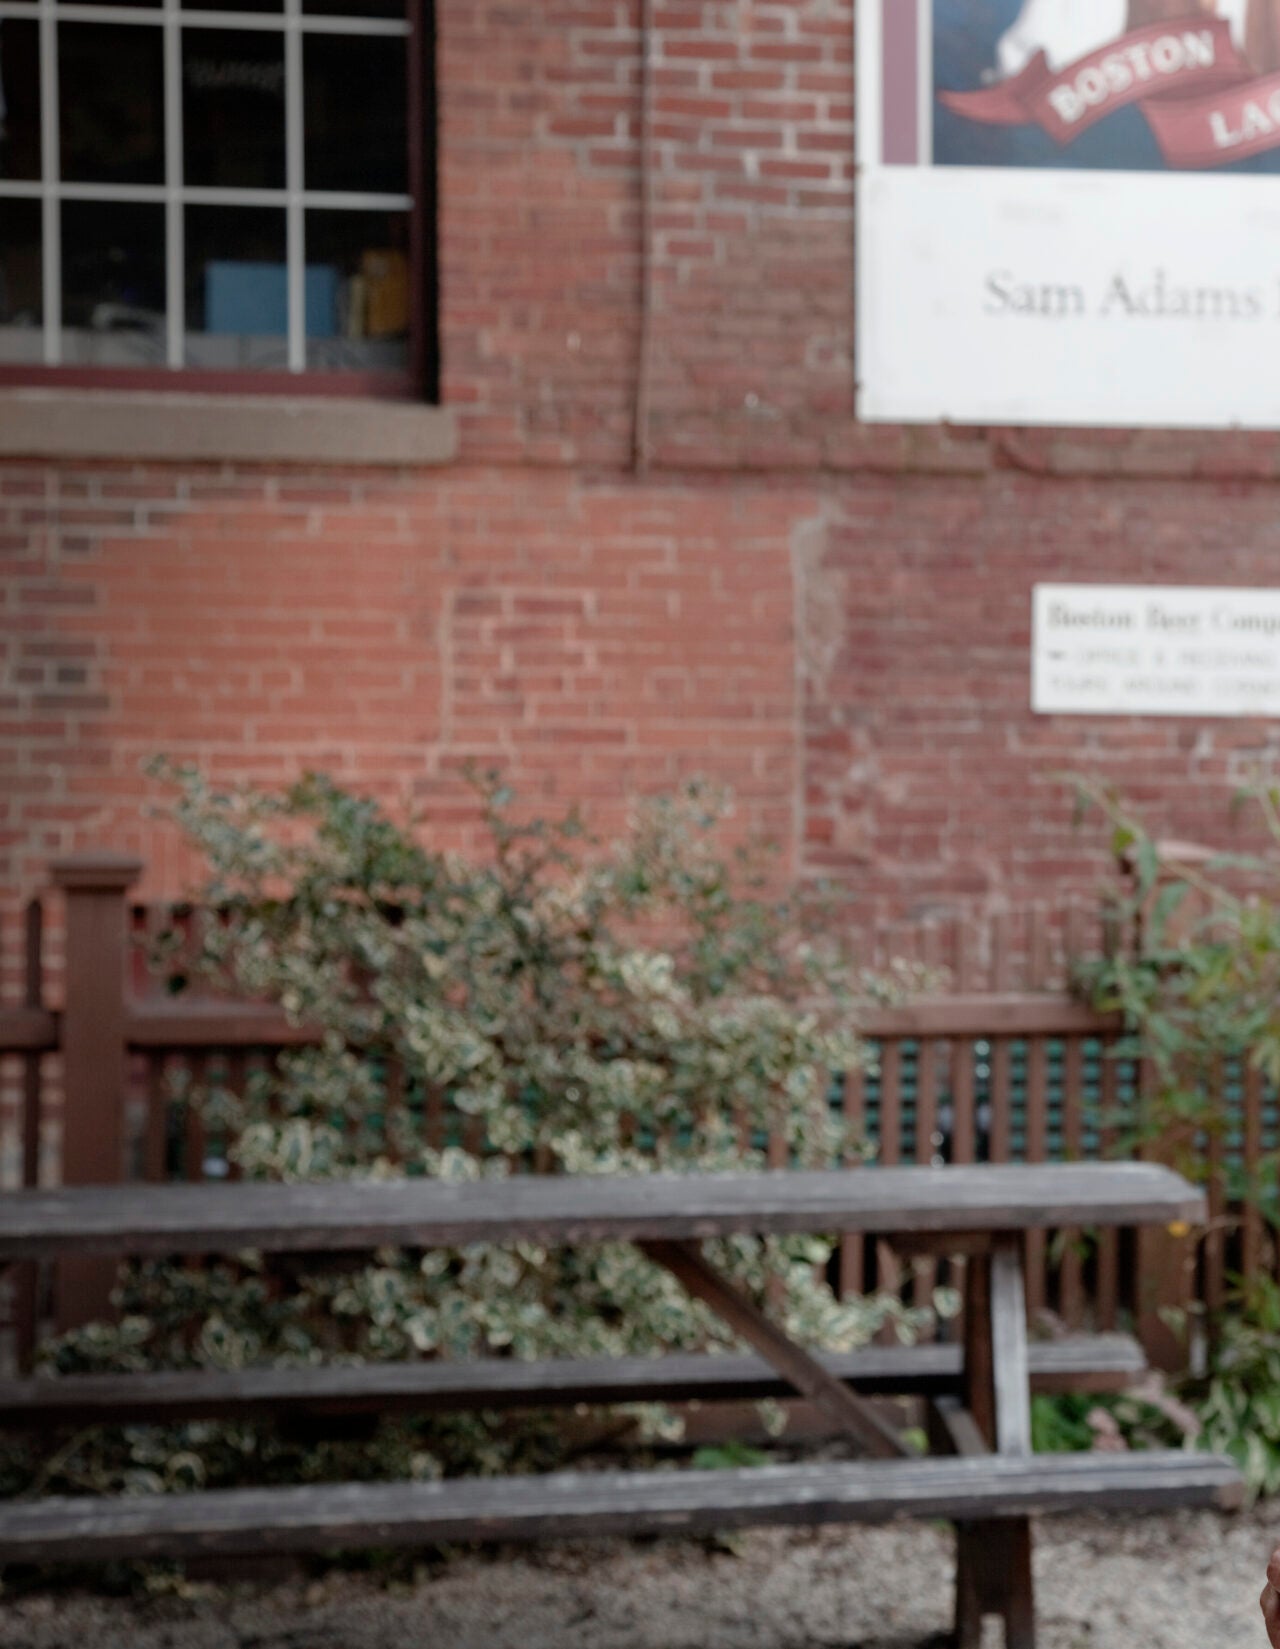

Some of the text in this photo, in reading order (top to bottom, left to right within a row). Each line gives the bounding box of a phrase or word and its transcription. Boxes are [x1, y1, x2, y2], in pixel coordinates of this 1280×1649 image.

[1047, 28, 1215, 124] BOSTON
[981, 267, 1086, 319] Sam
[1098, 265, 1263, 320] Adams
